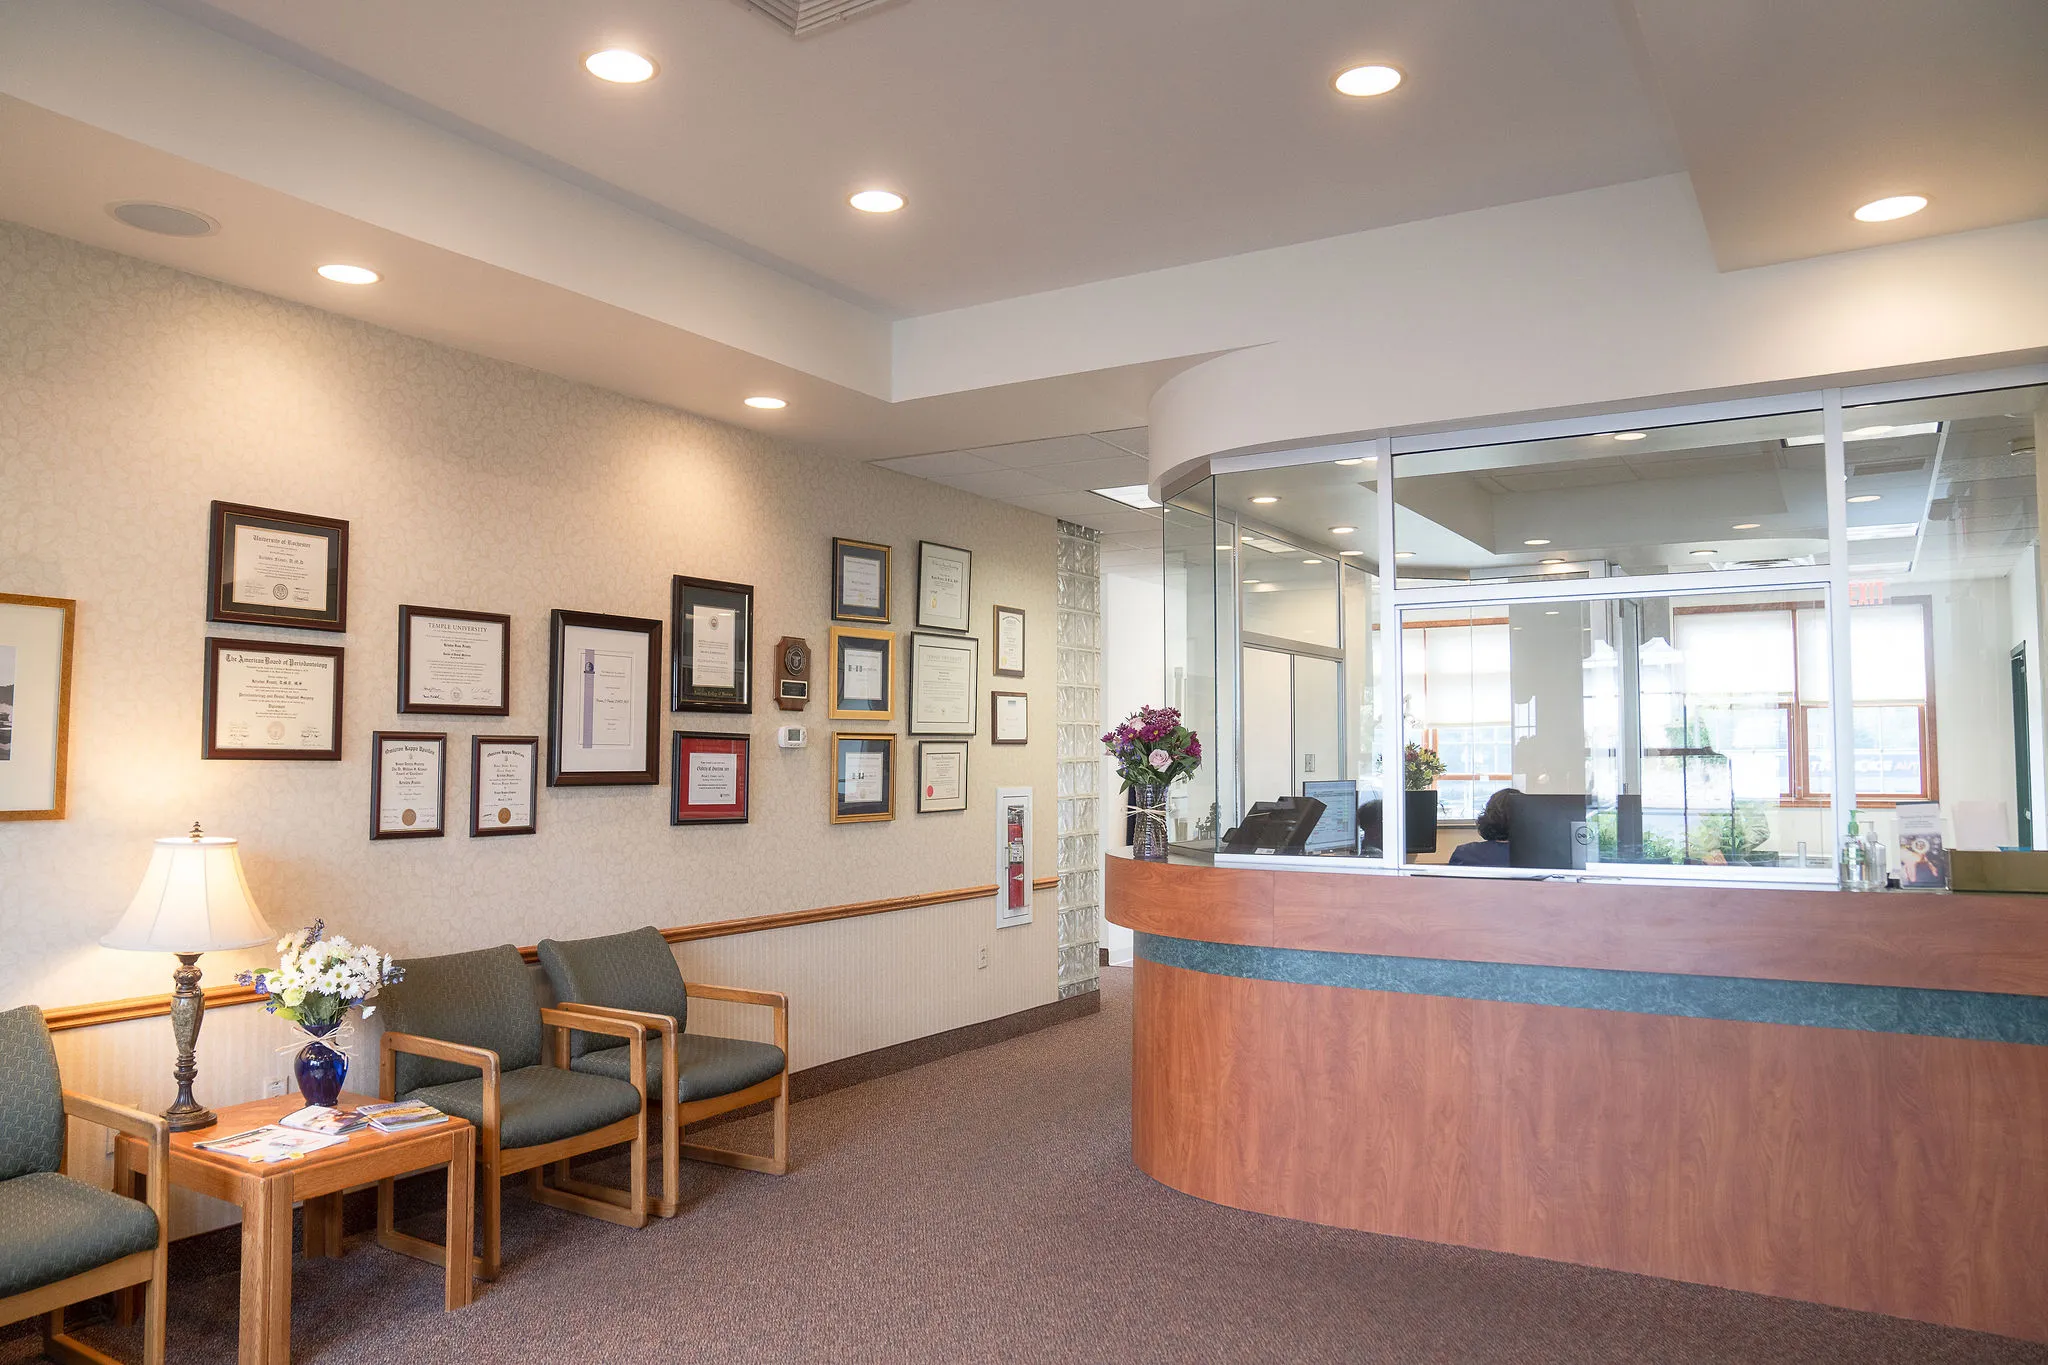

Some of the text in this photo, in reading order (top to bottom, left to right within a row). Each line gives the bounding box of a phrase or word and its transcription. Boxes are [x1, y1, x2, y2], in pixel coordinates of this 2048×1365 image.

[1848, 581, 1884, 606] EXIT
[428, 622, 452, 631] TEMPLE
[452, 624, 488, 633] UNIVERSITY
[225, 653, 237, 663] The
[238, 654, 264, 664] American
[264, 656, 281, 665] Board
[288, 658, 328, 669] Periodontology
